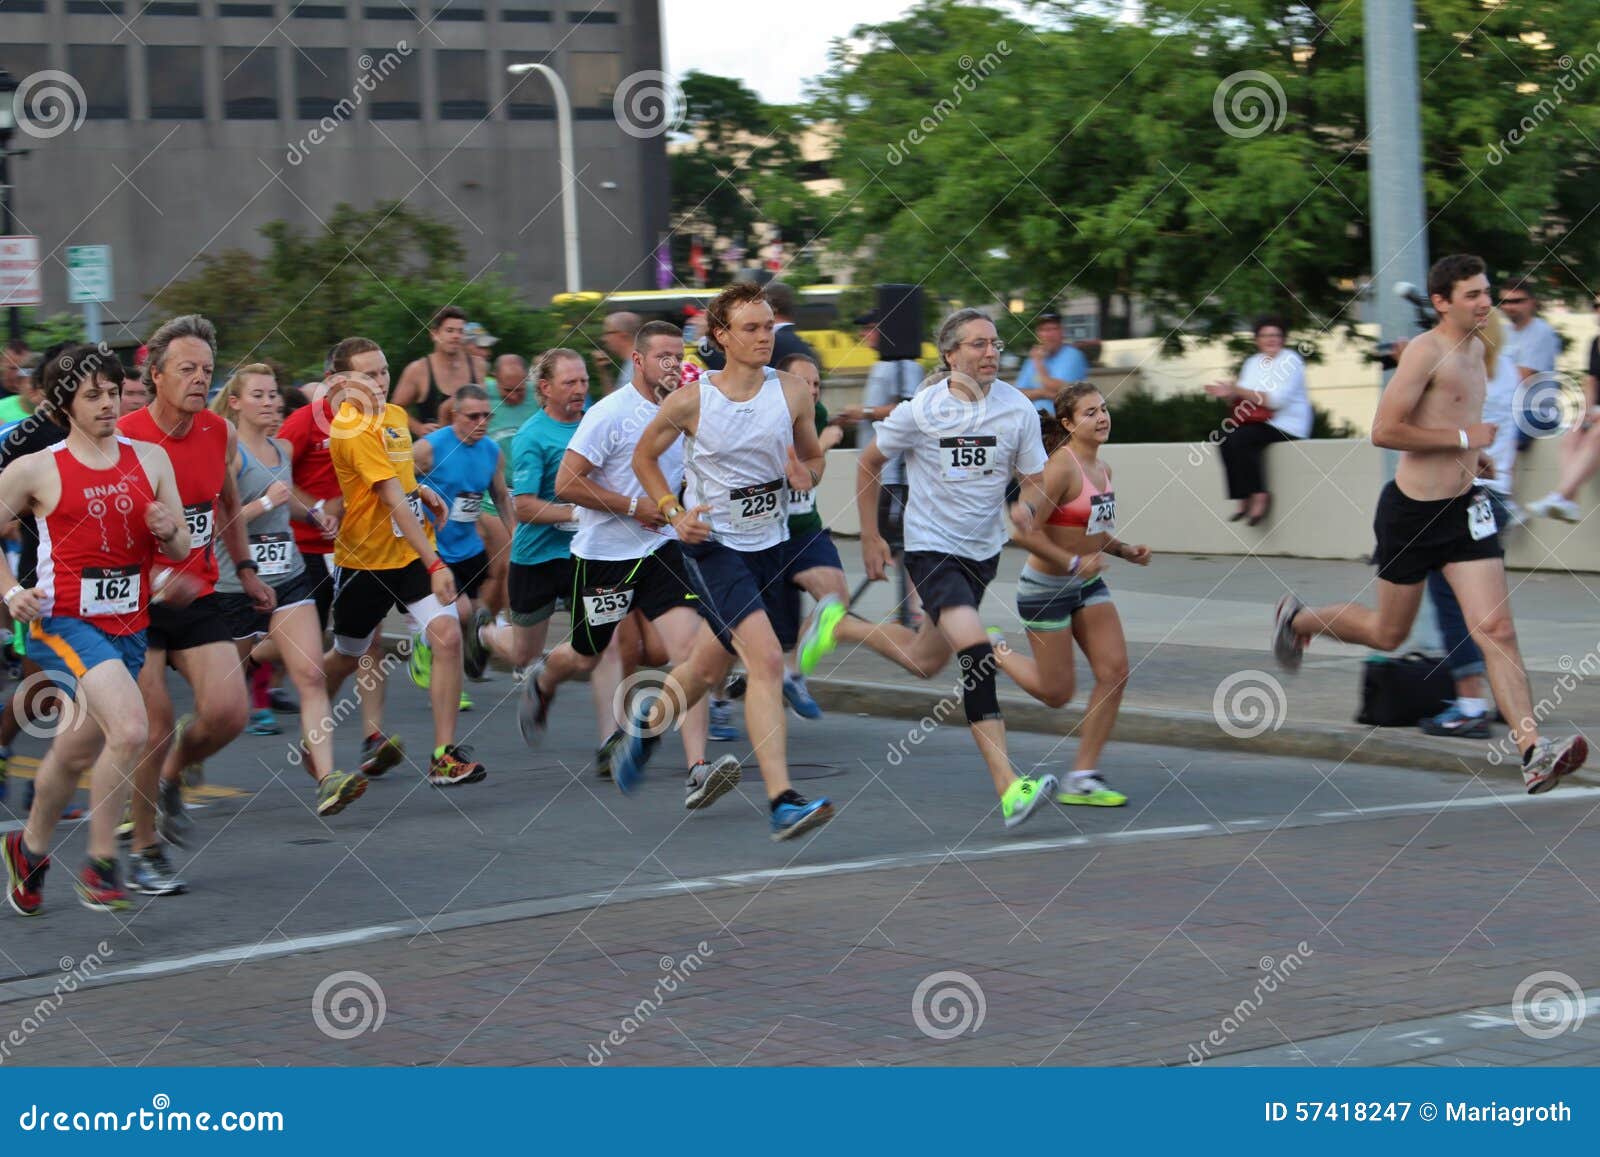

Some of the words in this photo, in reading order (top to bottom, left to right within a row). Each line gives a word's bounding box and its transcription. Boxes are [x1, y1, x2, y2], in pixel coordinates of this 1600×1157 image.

[951, 448, 986, 467] 158
[84, 482, 129, 499] BNAC
[741, 493, 777, 517] 229
[256, 543, 286, 562] 267
[95, 578, 130, 601] 162
[592, 593, 629, 614] 253
